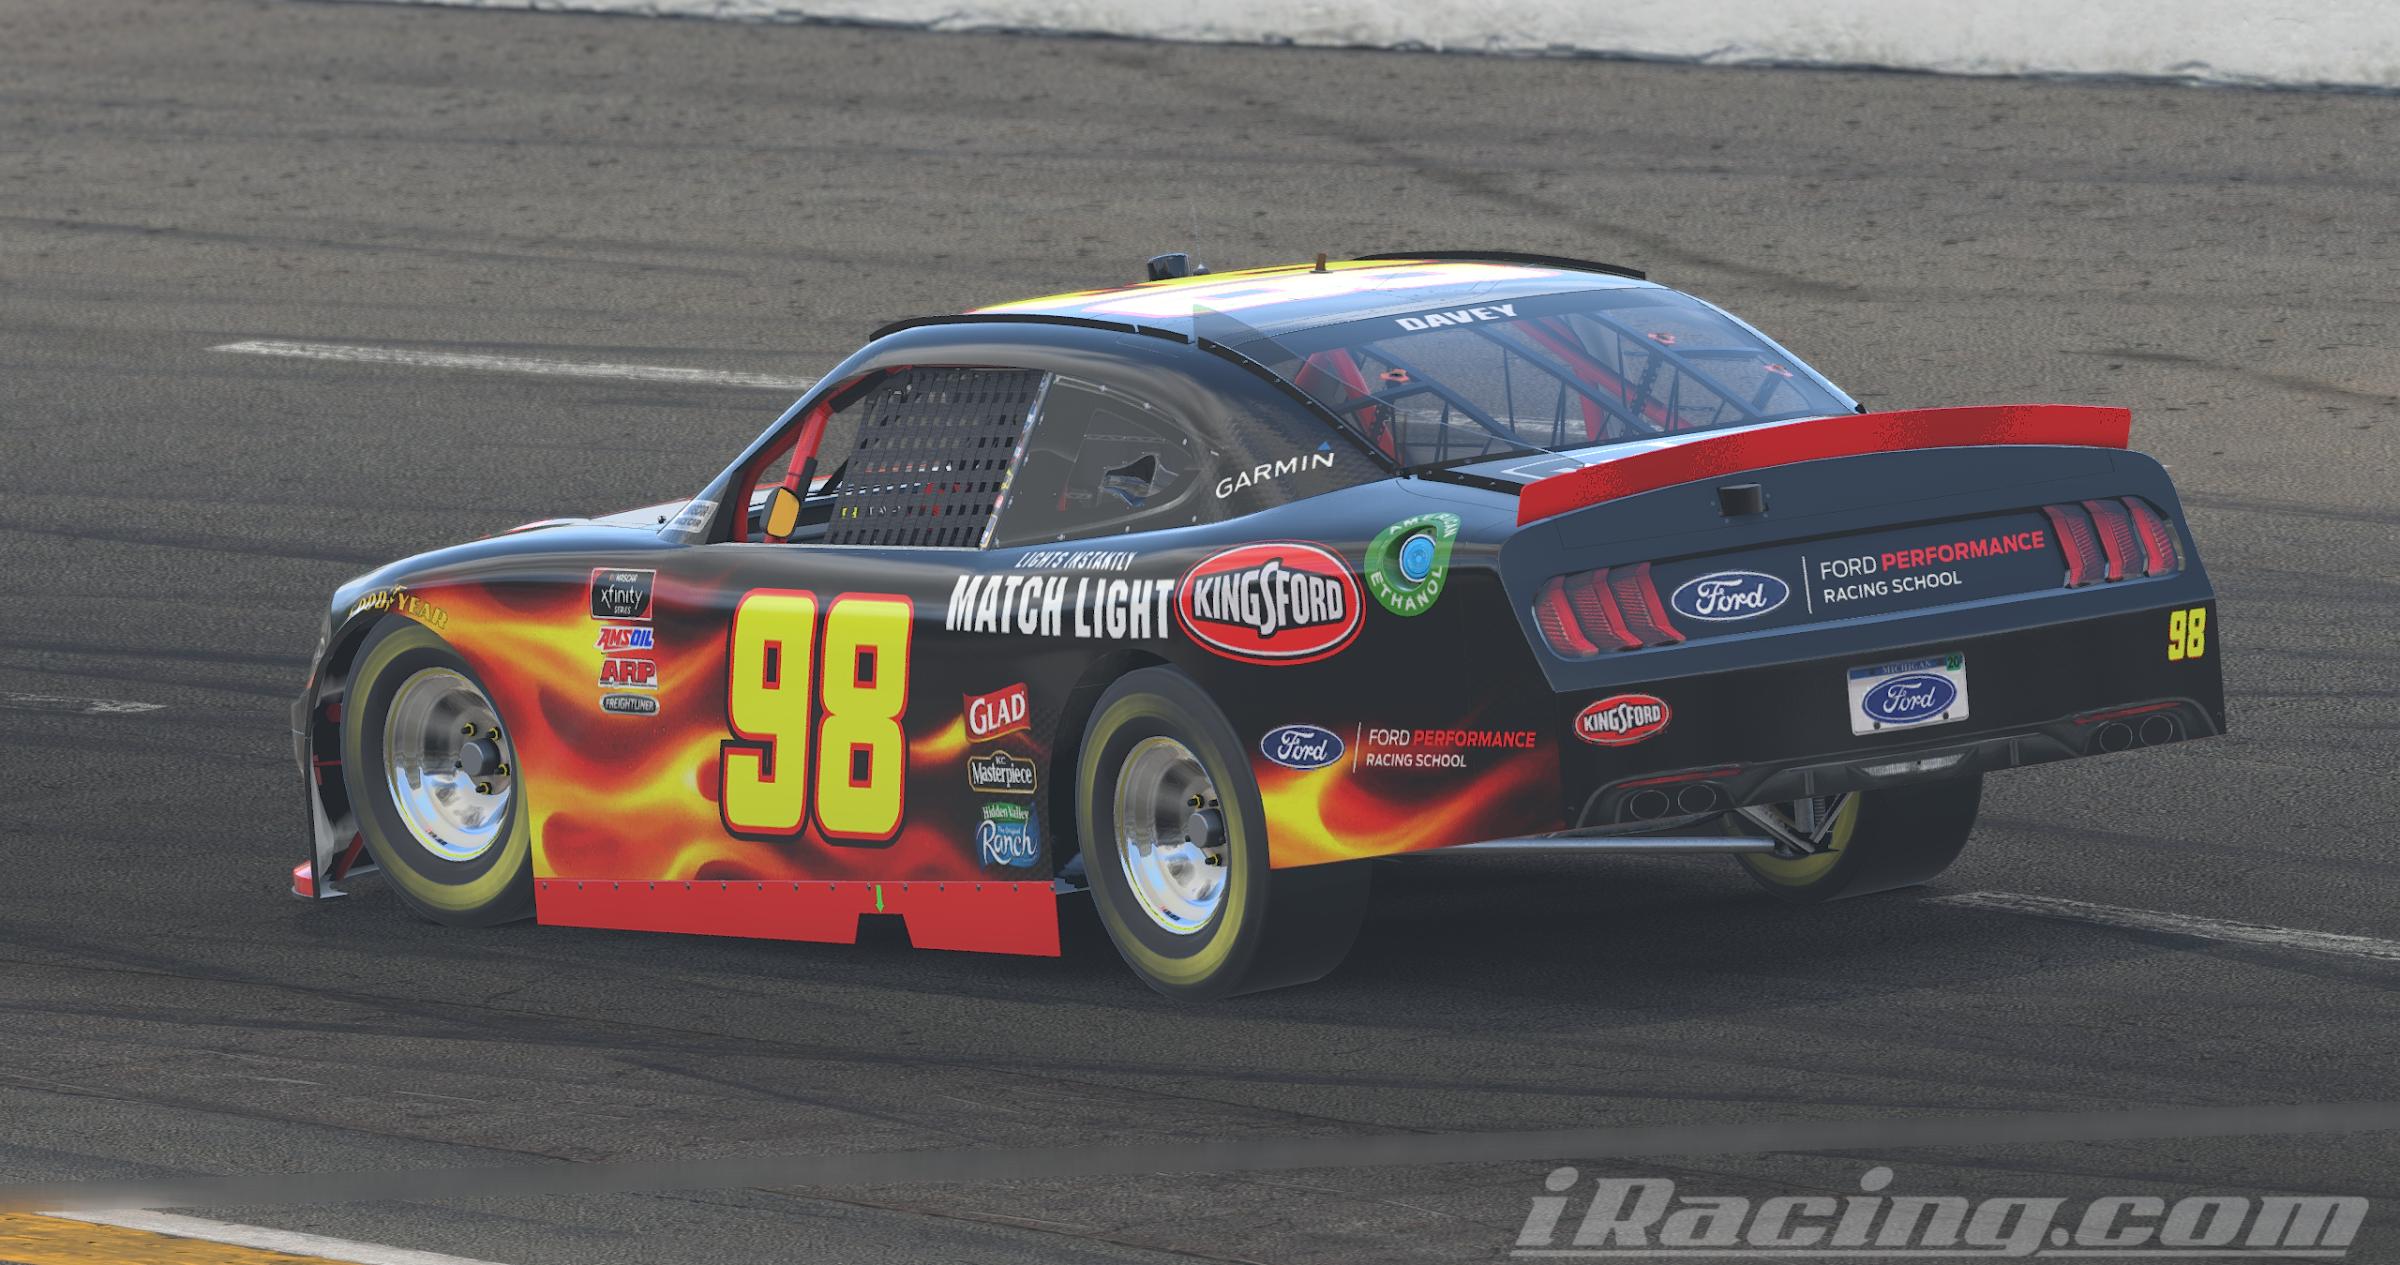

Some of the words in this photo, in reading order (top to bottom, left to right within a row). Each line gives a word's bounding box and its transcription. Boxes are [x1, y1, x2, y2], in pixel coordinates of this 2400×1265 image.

[1395, 303, 1518, 332] DAVEY
[1215, 451, 1336, 500] GARMIN
[1014, 551, 1069, 569] LIGHTS
[1063, 551, 1137, 571] INSTANTLY
[1820, 555, 1877, 580] FORD
[1881, 530, 2046, 573] PERFORMANCE
[601, 584, 643, 610] xfinity
[1194, 558, 1344, 637] KINGSFORD
[1370, 566, 1443, 611] ETHANOL
[1694, 577, 1768, 614] Ford
[1823, 580, 1889, 603] RACING
[1892, 570, 1963, 594] SCHOOL
[945, 574, 1068, 637] MATCH
[1074, 576, 1175, 640] LIGHT
[597, 627, 653, 650] AMSOIL
[2167, 607, 2207, 661] 98
[600, 660, 655, 683] ARP
[605, 697, 655, 711] FREIGHTLINER
[1883, 682, 1936, 713] Ford
[722, 588, 914, 841] 98
[1583, 702, 1661, 734] KINGSFORD
[1277, 730, 1328, 762] Ford
[1368, 729, 1411, 747] FORD
[1413, 729, 1536, 749] PERFORMANCE
[972, 761, 1033, 788] Masterpiece
[1366, 753, 1413, 768] RACING
[1415, 753, 1467, 769] SCHOOL
[976, 820, 1038, 865] Ranch
